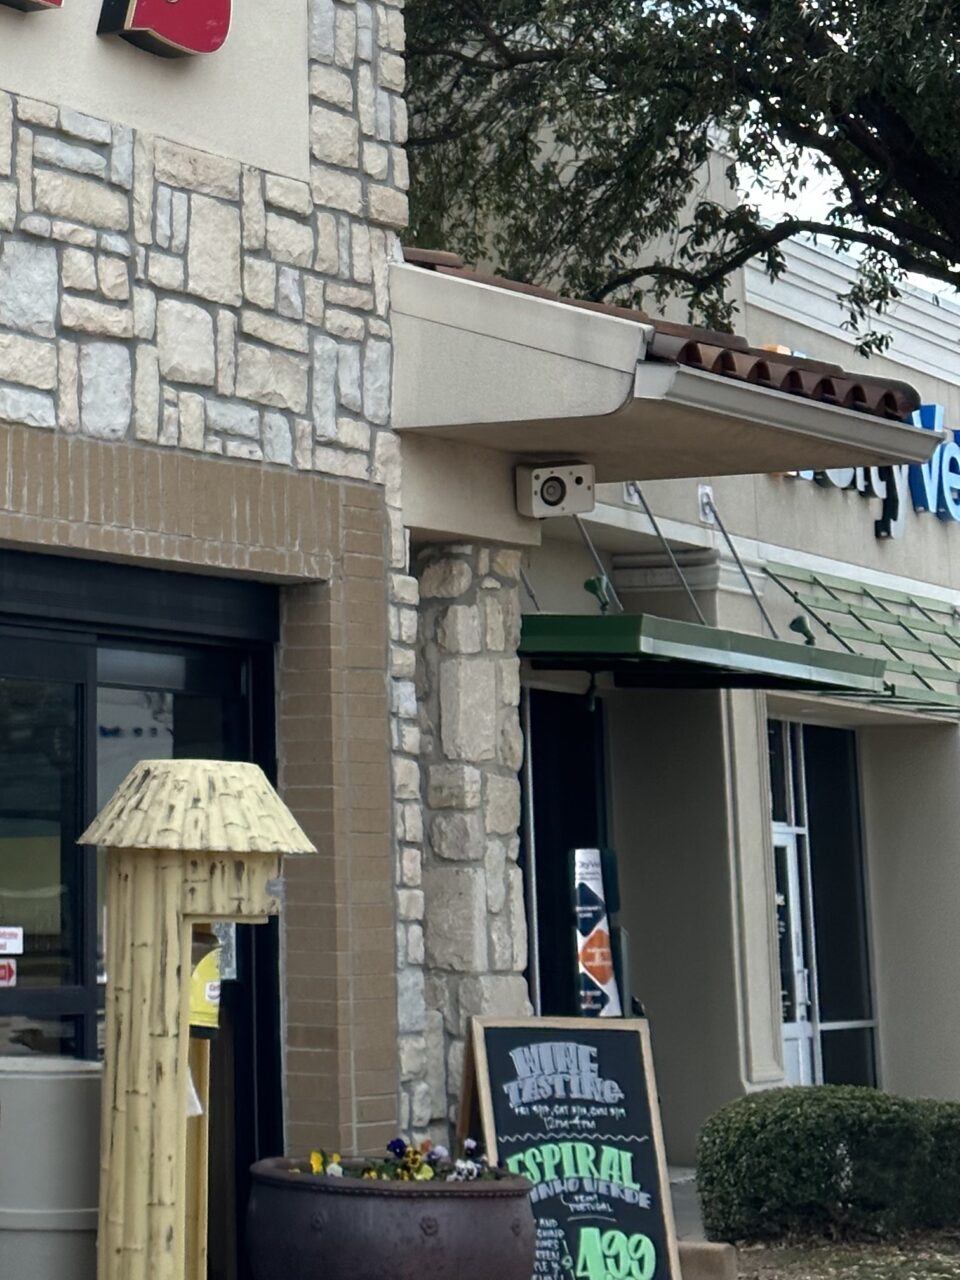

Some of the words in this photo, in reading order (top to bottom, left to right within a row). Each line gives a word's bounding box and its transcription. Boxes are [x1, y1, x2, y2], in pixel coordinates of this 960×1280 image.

[509, 1041, 599, 1078] WINE
[502, 1073, 625, 1108] TASTING
[505, 1141, 641, 1190] ESPIRAL
[529, 1178, 581, 1203] INHO
[583, 1177, 652, 1209] VERDE
